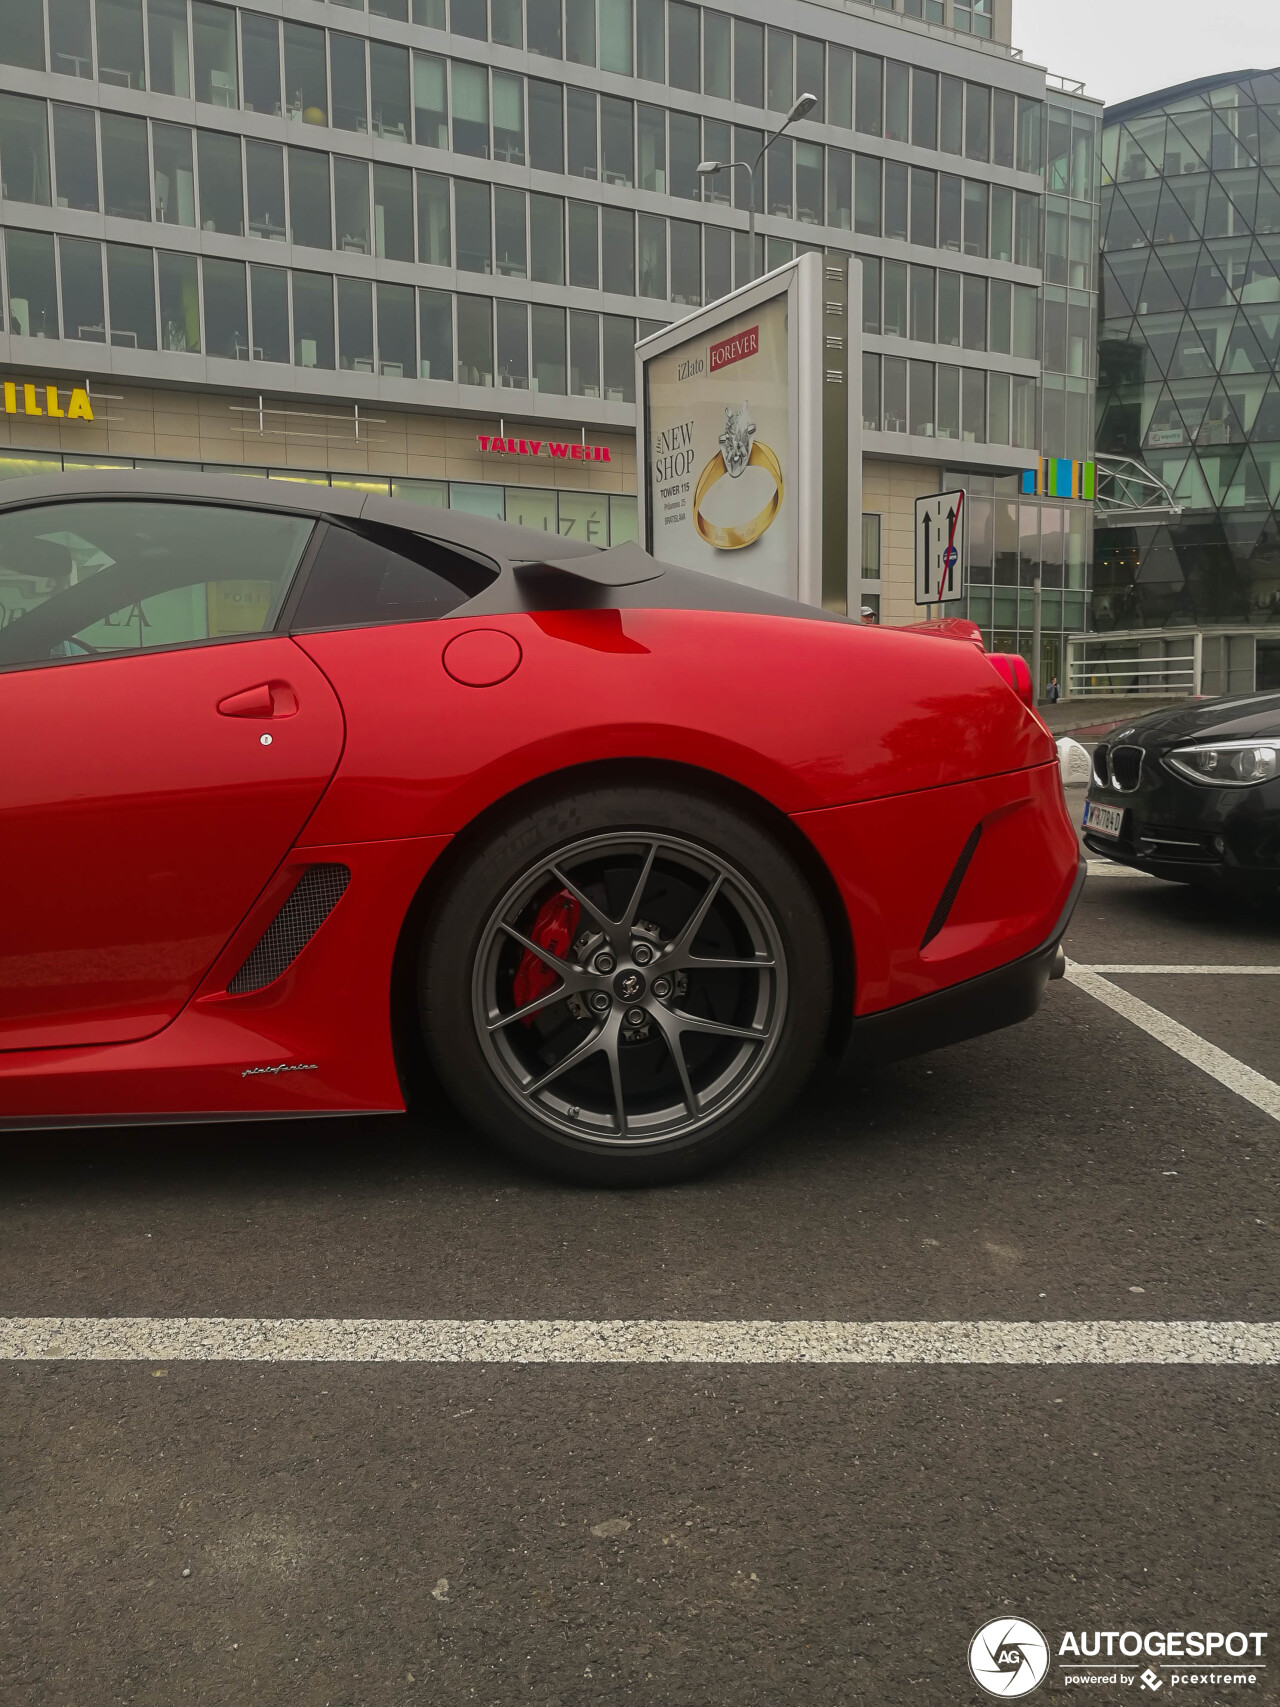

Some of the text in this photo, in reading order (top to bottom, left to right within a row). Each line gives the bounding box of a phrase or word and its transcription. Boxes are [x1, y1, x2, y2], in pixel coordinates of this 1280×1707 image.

[678, 334, 757, 381] iZlato FOREVER
[477, 435, 542, 456] TALLY
[661, 421, 694, 454] NEW
[656, 449, 694, 482] SHOP
[660, 482, 690, 498] TOWER 115
